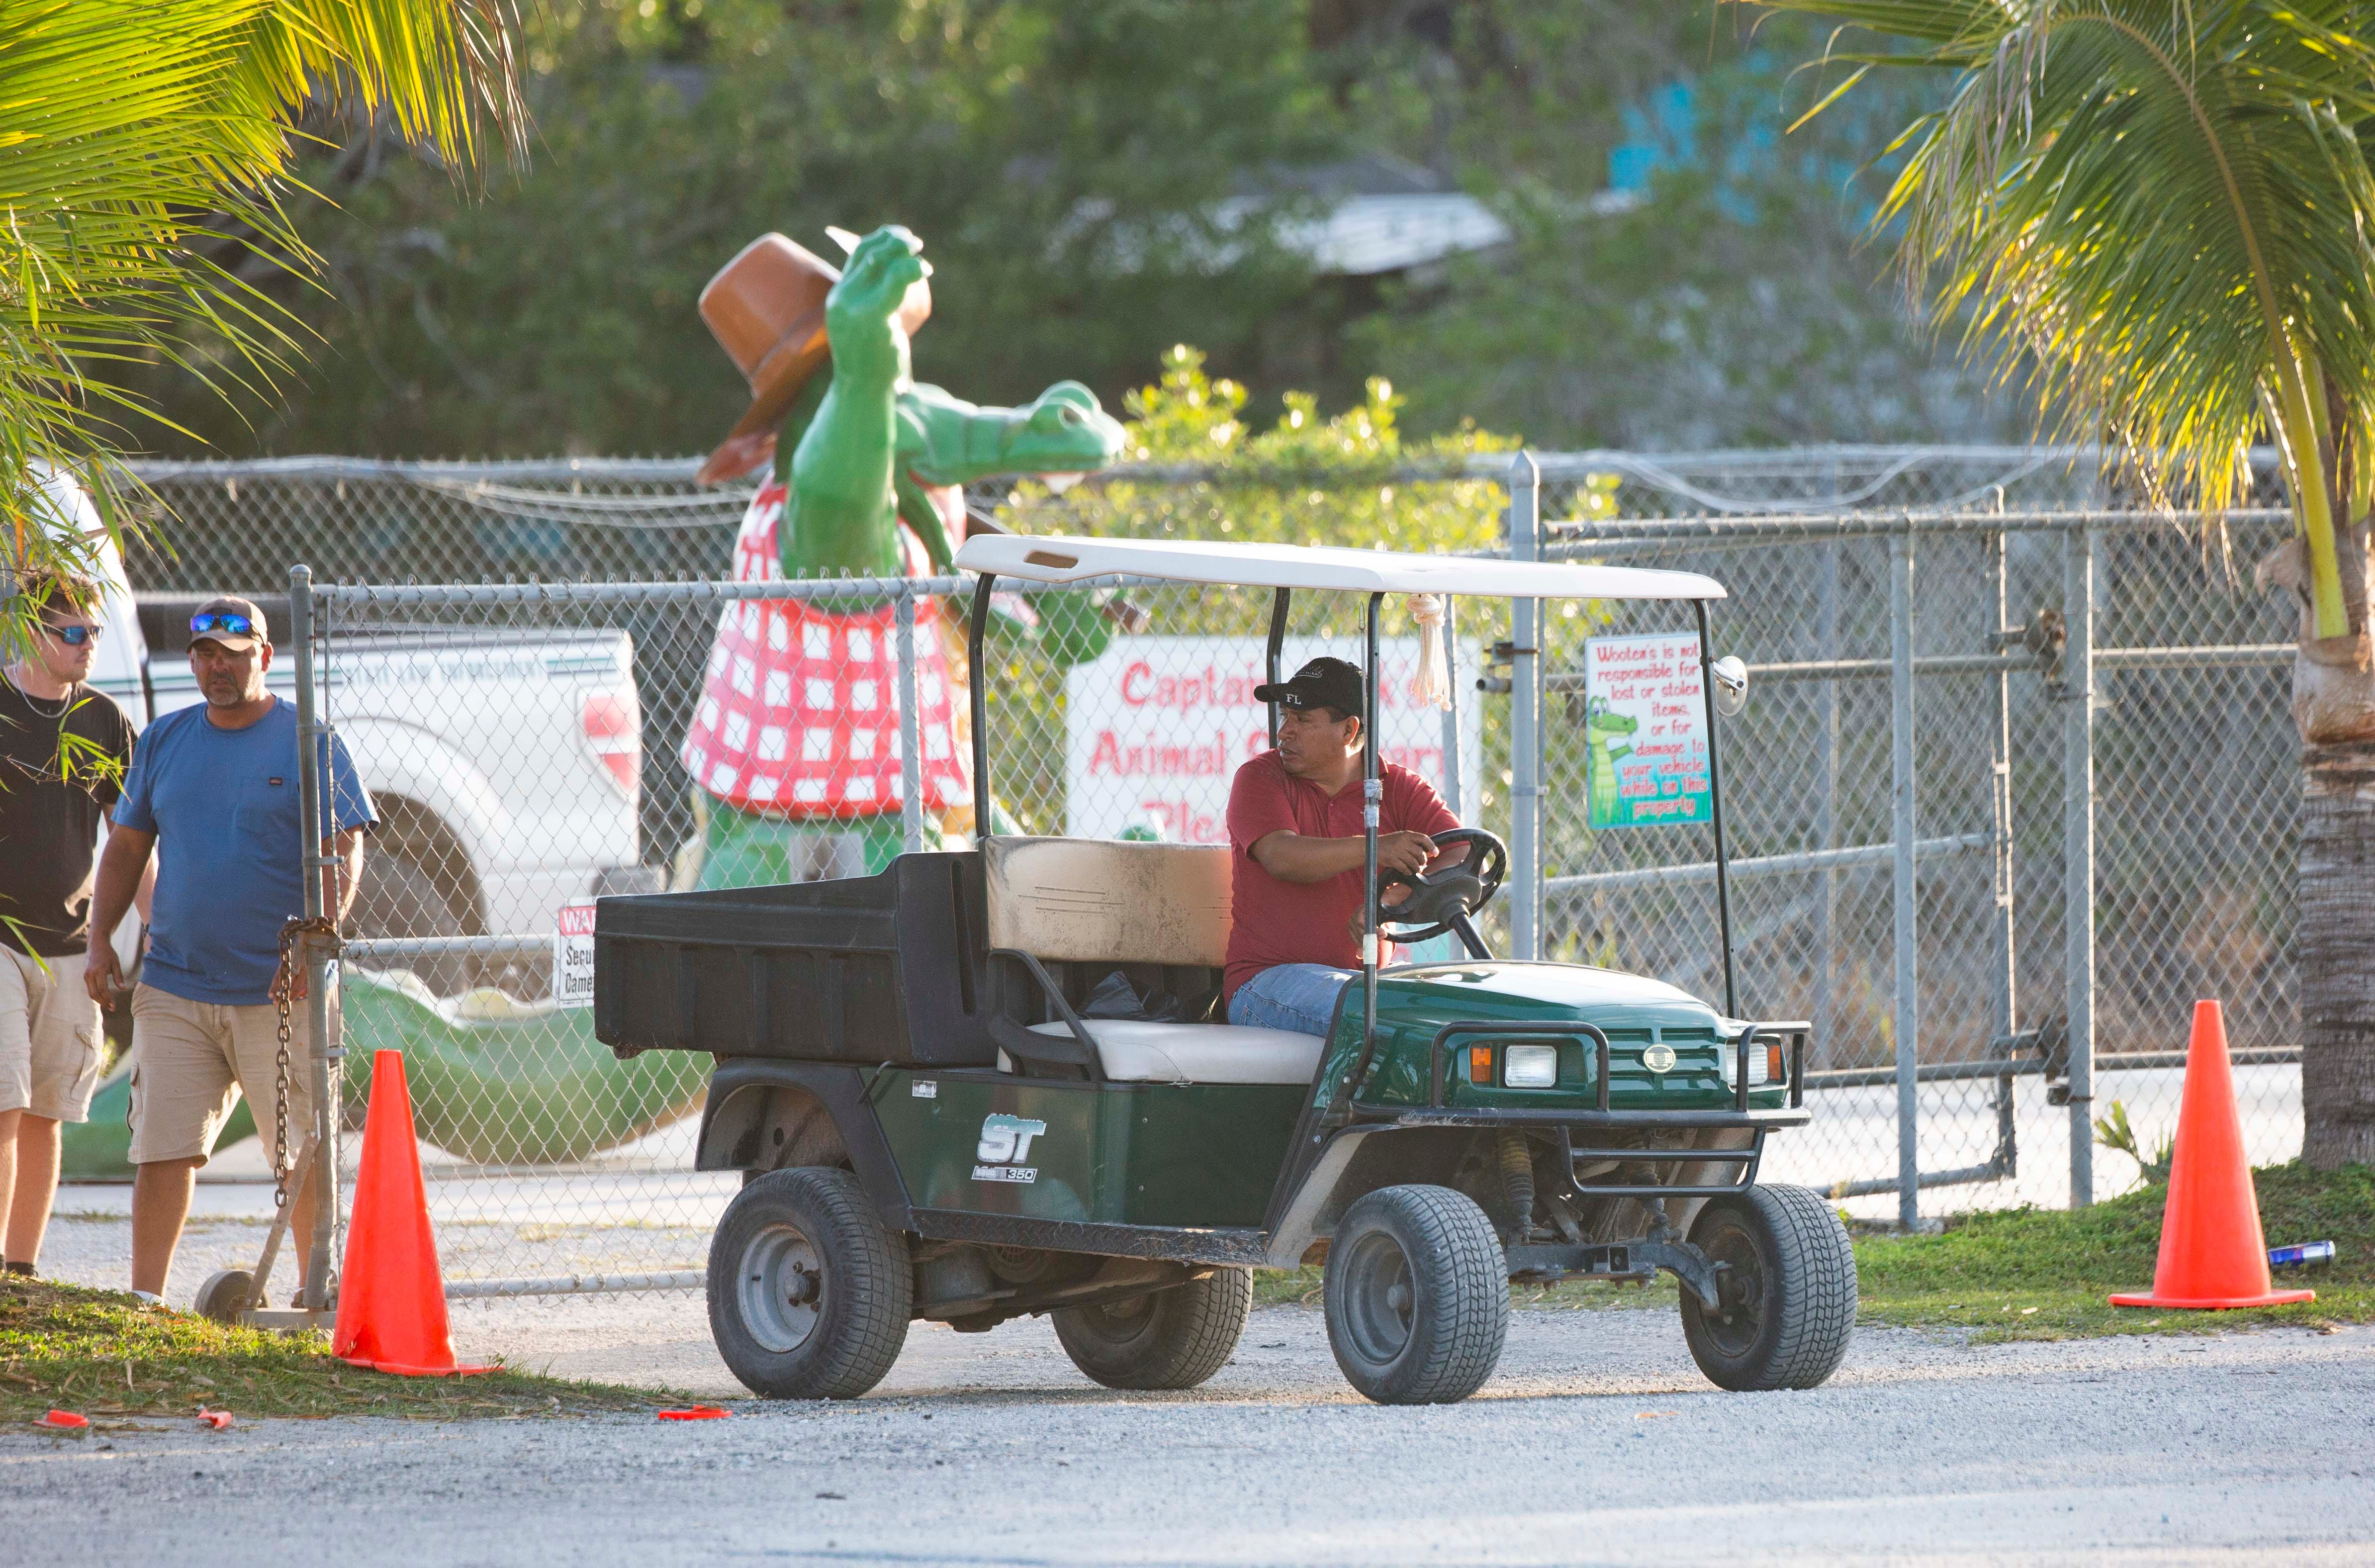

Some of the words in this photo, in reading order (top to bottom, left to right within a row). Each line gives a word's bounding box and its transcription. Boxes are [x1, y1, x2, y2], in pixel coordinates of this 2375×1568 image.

[1596, 645, 1656, 662] Wooten's
[1662, 644, 1674, 659] is
[1680, 642, 1699, 657] not
[1597, 662, 1674, 683] responsible
[1679, 660, 1698, 677] for
[1286, 693, 1301, 705] FL
[1611, 684, 1635, 700] lost
[1641, 686, 1655, 698] or
[1661, 681, 1699, 697] stolen
[1650, 725, 1665, 737] or
[1671, 719, 1691, 735] for
[1090, 731, 1226, 776] Animal
[1636, 741, 1685, 758] damage
[1692, 738, 1705, 752] to
[1623, 764, 1651, 780] your
[1658, 756, 1705, 774] vehicle
[1621, 778, 1656, 796] while
[1662, 781, 1677, 794] on
[1682, 776, 1708, 793] this
[1633, 796, 1696, 820] property
[566, 946, 594, 966] Secu
[977, 1113, 1047, 1164] ST
[1007, 1169, 1034, 1180] 350
